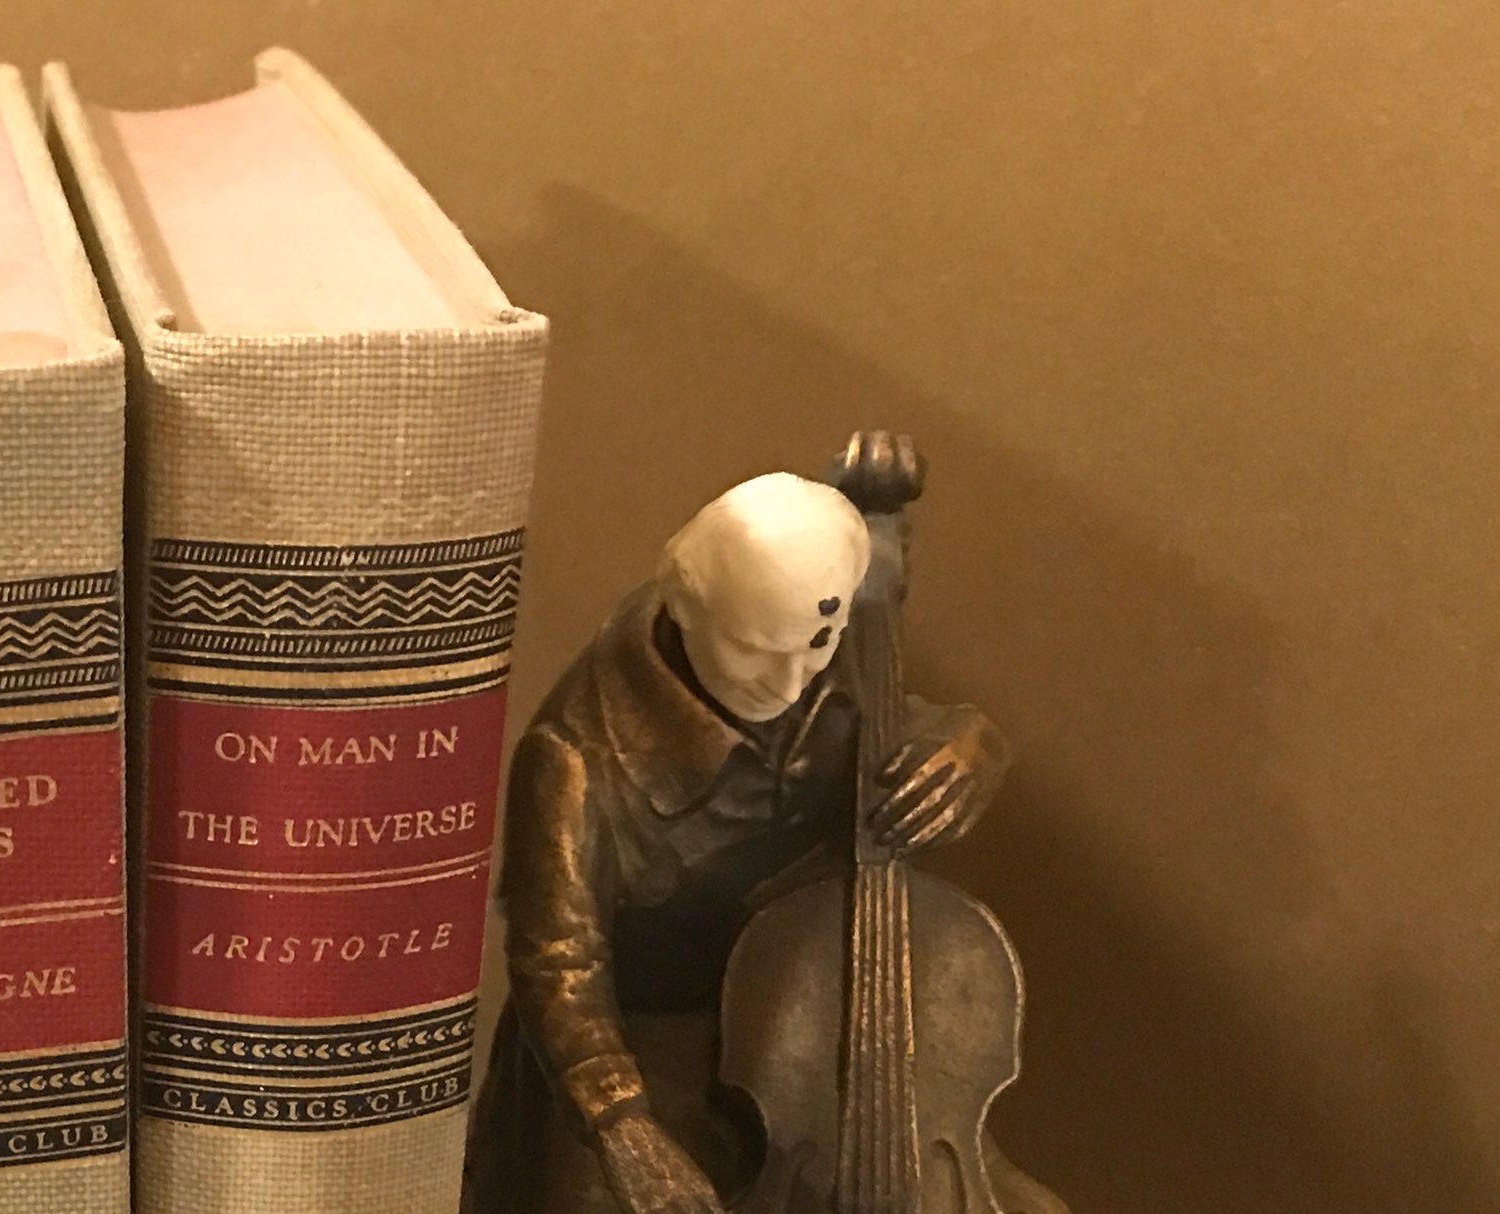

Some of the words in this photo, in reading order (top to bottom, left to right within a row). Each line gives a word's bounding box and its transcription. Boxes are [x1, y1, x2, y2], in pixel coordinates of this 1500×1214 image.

[214, 731, 278, 764] ON
[298, 735, 397, 766] MAN
[417, 725, 460, 758] IN
[178, 809, 259, 846] THE
[284, 801, 476, 848] UNIVERSE
[192, 922, 454, 963] ARISTOTLE
[163, 1088, 347, 1120] CLASSICS
[370, 1077, 459, 1113] CLUB
[8, 1125, 109, 1154] CLUB
